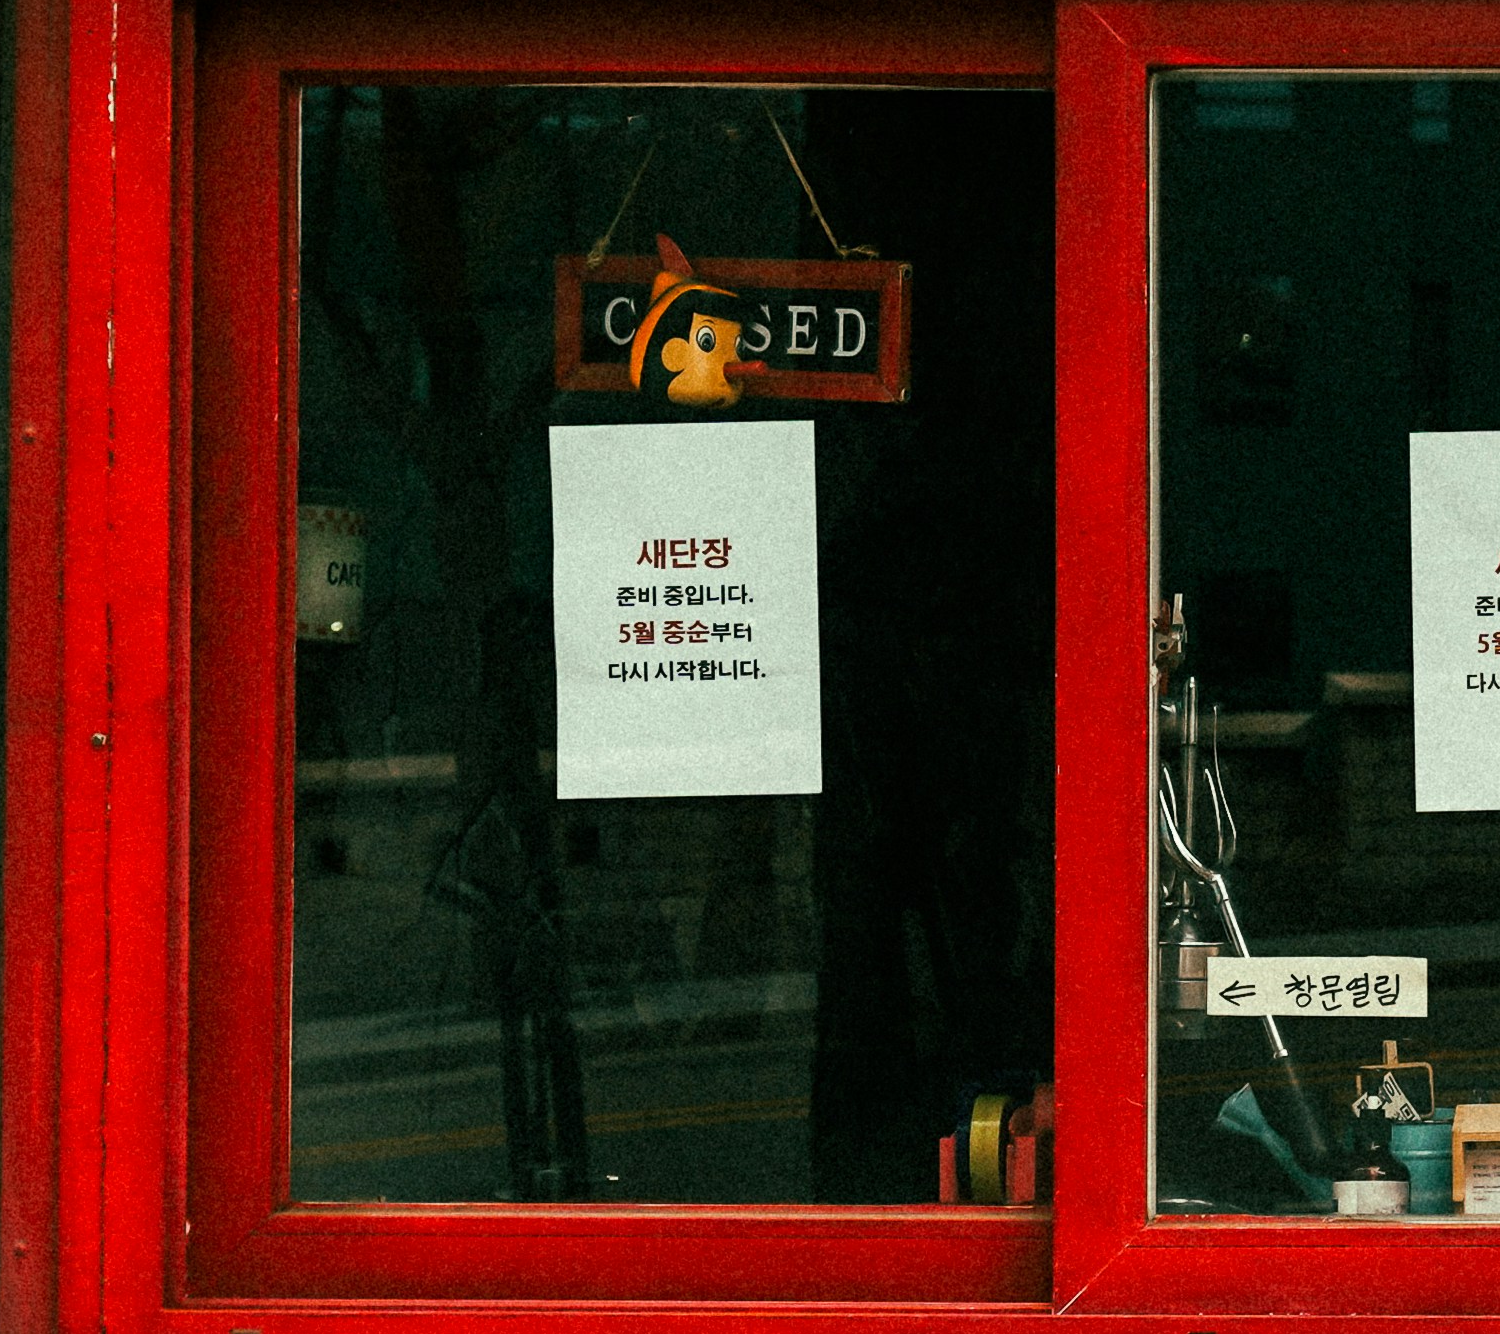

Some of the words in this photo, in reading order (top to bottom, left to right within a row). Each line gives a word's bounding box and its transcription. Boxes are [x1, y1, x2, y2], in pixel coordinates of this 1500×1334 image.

[636, 537, 732, 569] 새단장
[616, 586, 657, 607] 준비
[663, 584, 754, 607] 중입니다.
[619, 621, 655, 644] 5월
[662, 620, 752, 644] 중순부터
[608, 662, 649, 682] 다시
[655, 659, 766, 682] 시작합니다.
[1284, 972, 1400, 1011] 창문열림
